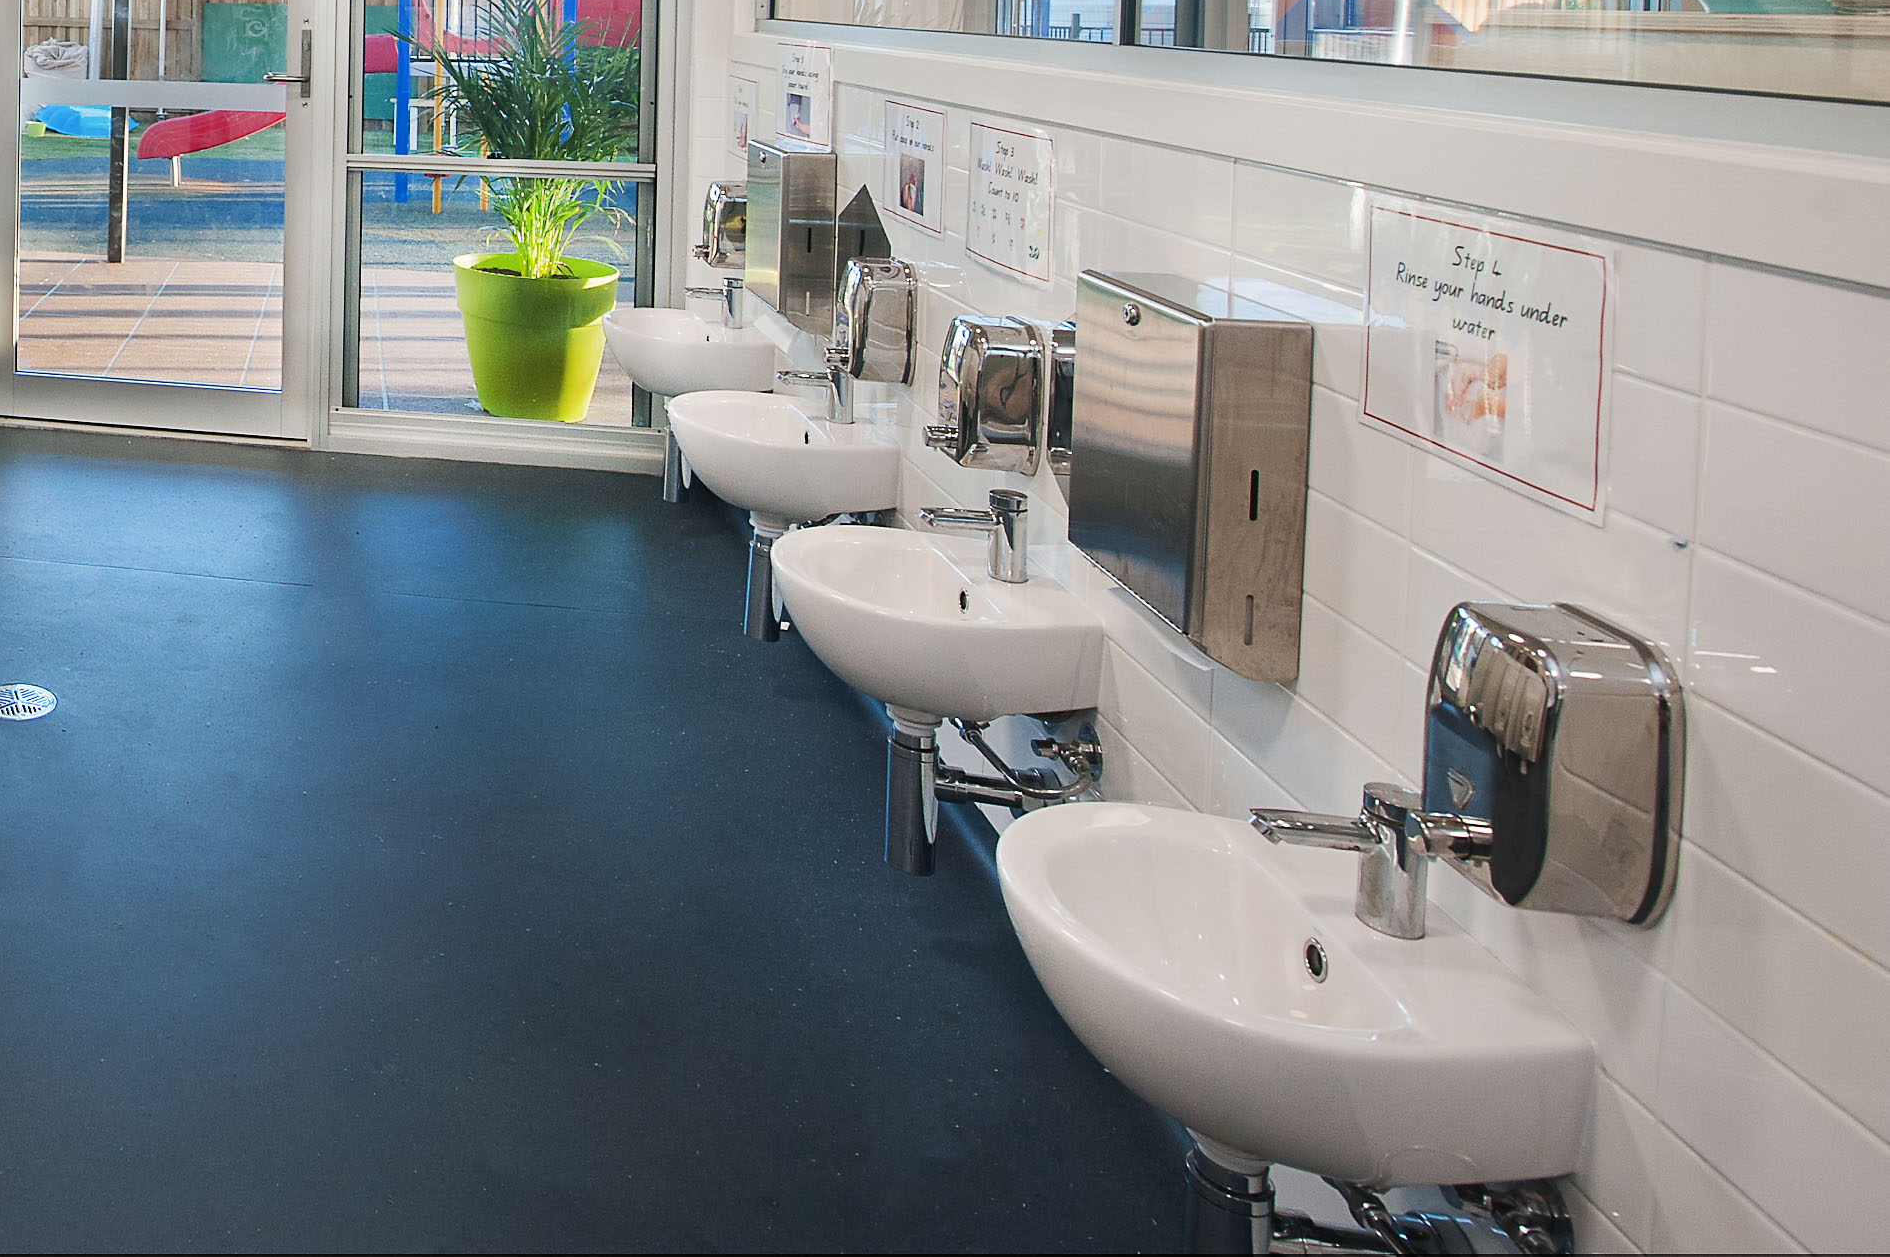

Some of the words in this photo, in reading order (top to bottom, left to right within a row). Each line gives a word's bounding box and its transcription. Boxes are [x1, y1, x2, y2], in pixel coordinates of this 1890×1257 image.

[995, 140, 1009, 163] Step
[1010, 146, 1015, 158] 3
[996, 162, 1016, 181] Wash!
[1018, 167, 1040, 185] Wash!
[988, 181, 1005, 198] Count
[1005, 189, 1012, 202] to
[1012, 191, 1022, 204] 10
[1452, 245, 1485, 282] Step
[1492, 260, 1502, 276] 4
[1396, 261, 1428, 289] Rinse
[1432, 279, 1464, 302] your
[1470, 282, 1514, 313] hands
[1520, 302, 1568, 328] under
[1452, 317, 1496, 340] water
